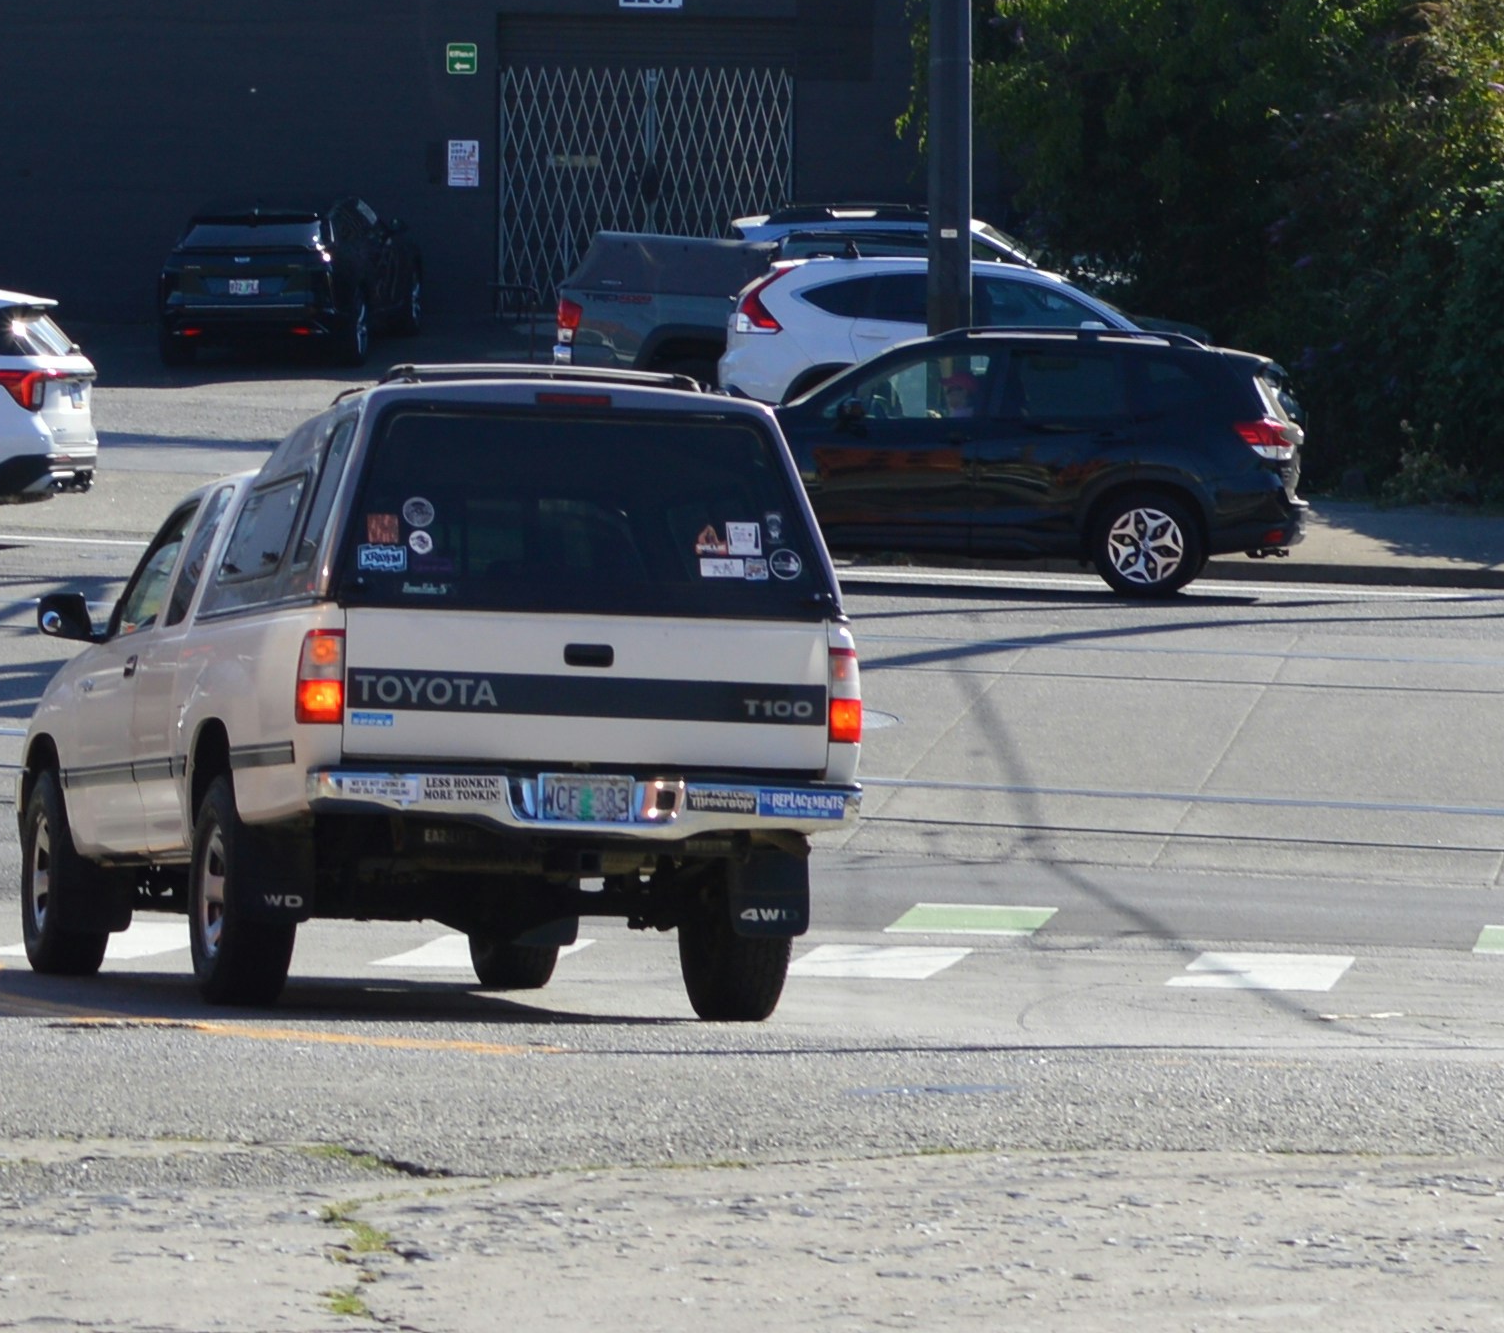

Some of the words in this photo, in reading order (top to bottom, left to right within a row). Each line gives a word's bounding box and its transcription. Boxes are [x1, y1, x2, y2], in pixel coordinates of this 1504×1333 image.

[355, 675, 498, 706] TOYOTA
[744, 699, 813, 717] T100
[426, 777, 451, 788] LESS
[424, 789, 453, 800] MORE
[772, 791, 844, 810] REPLACEMENTS
